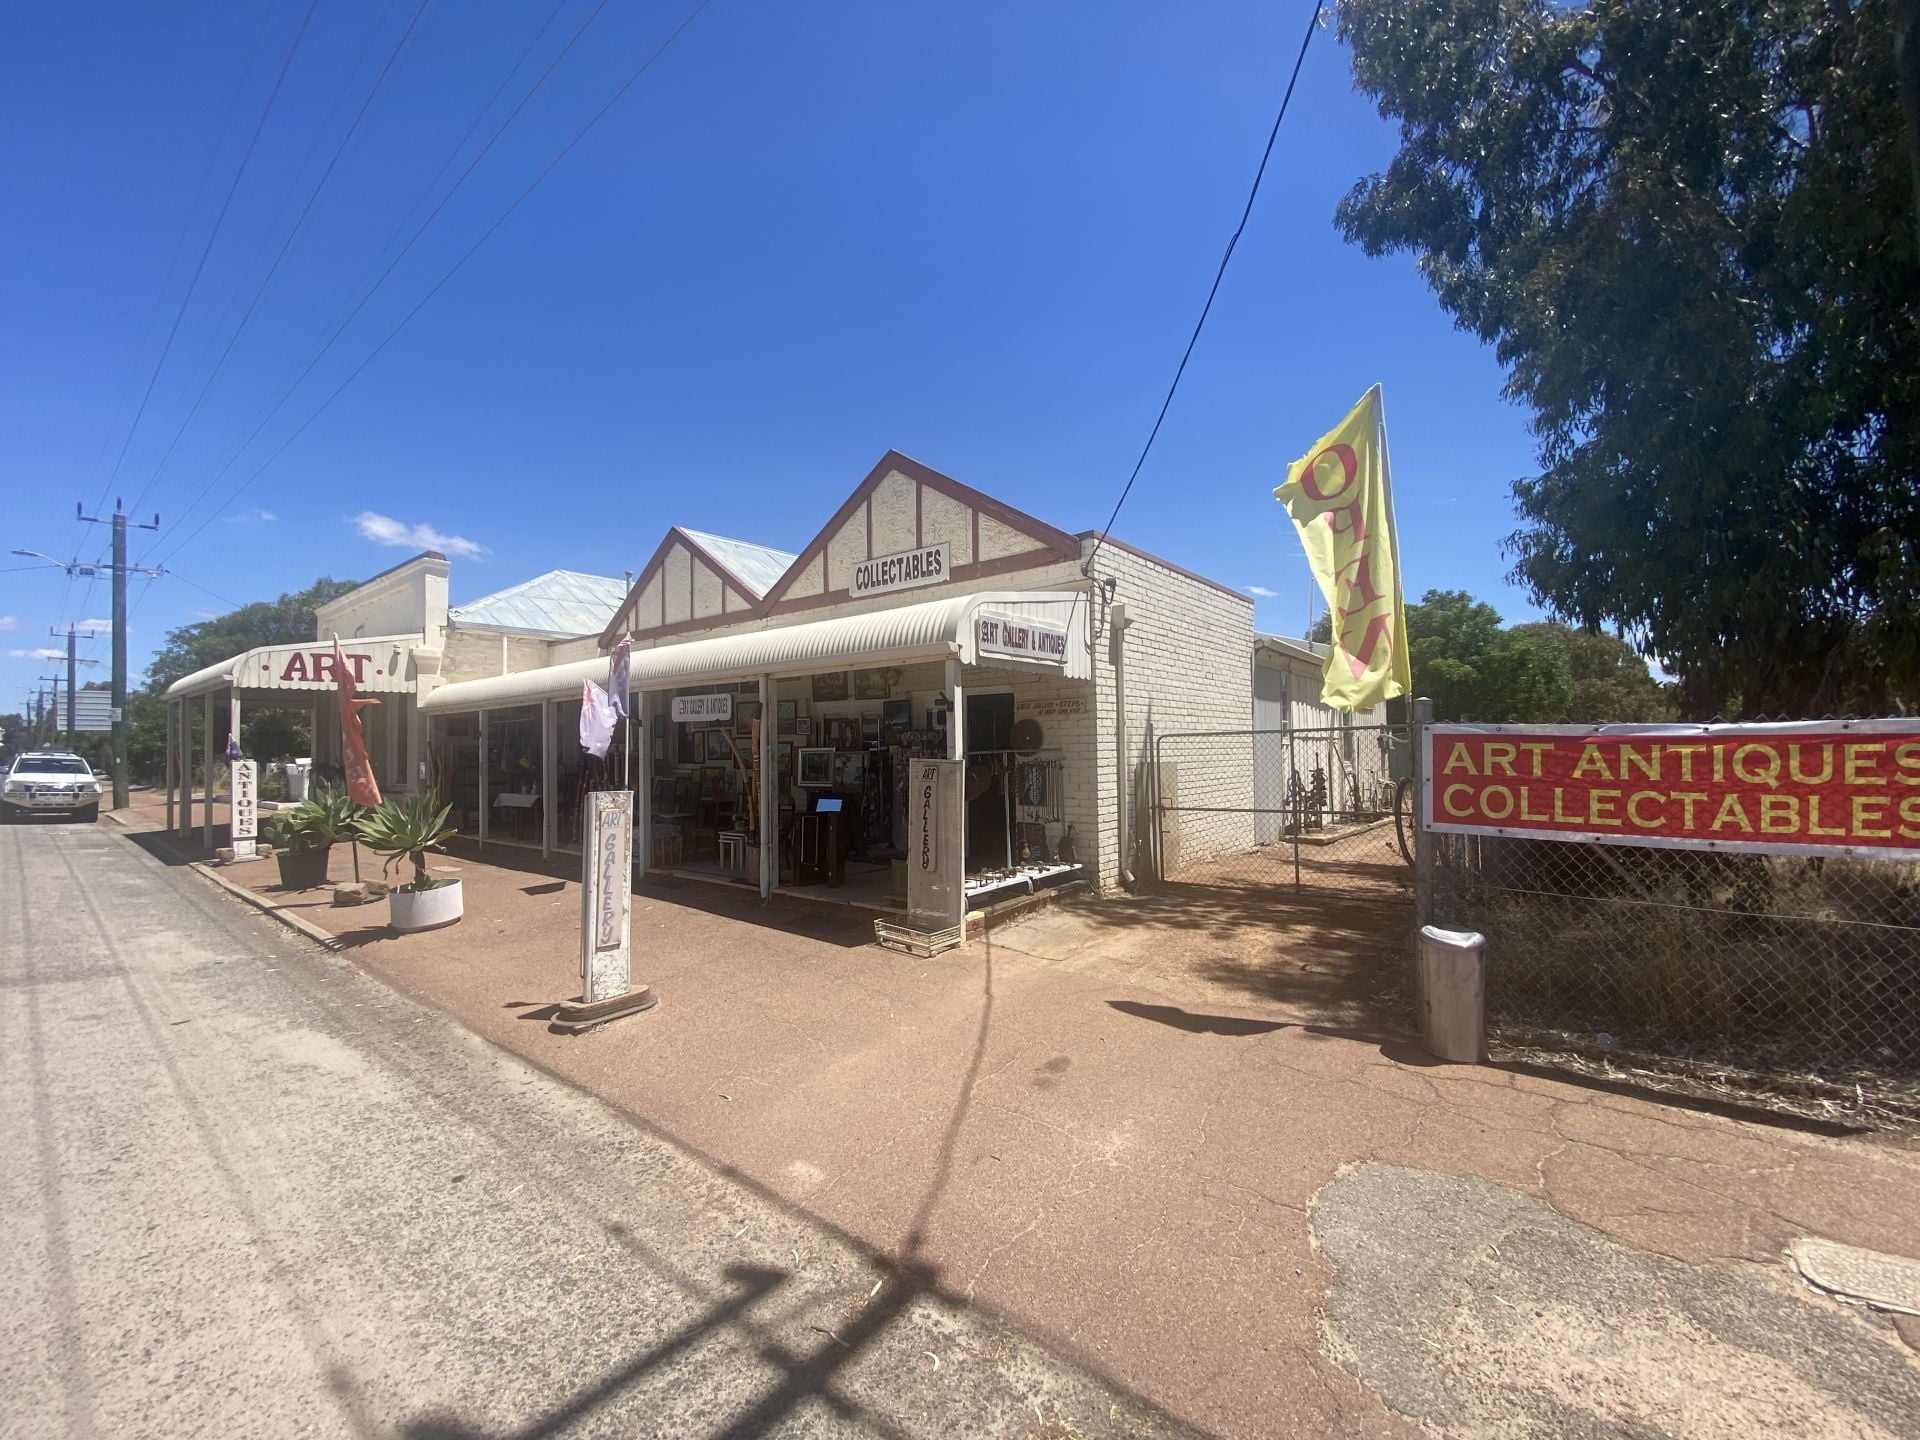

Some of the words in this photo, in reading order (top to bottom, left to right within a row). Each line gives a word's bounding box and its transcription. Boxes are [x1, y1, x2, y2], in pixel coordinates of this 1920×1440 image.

[855, 548, 942, 591] COLLECTABLES
[1002, 621, 1030, 650] GALLERY
[1031, 630, 1036, 651] &
[1037, 631, 1065, 655] ANTIQUES
[280, 651, 372, 683] ART
[922, 767, 936, 781] ART
[1441, 741, 1554, 777] ART
[1571, 742, 1920, 790] ANTIQUES
[237, 763, 253, 836] ANTIQUES
[601, 811, 620, 828] ART
[921, 785, 932, 870] GALLERY
[600, 833, 617, 944] GALLERY
